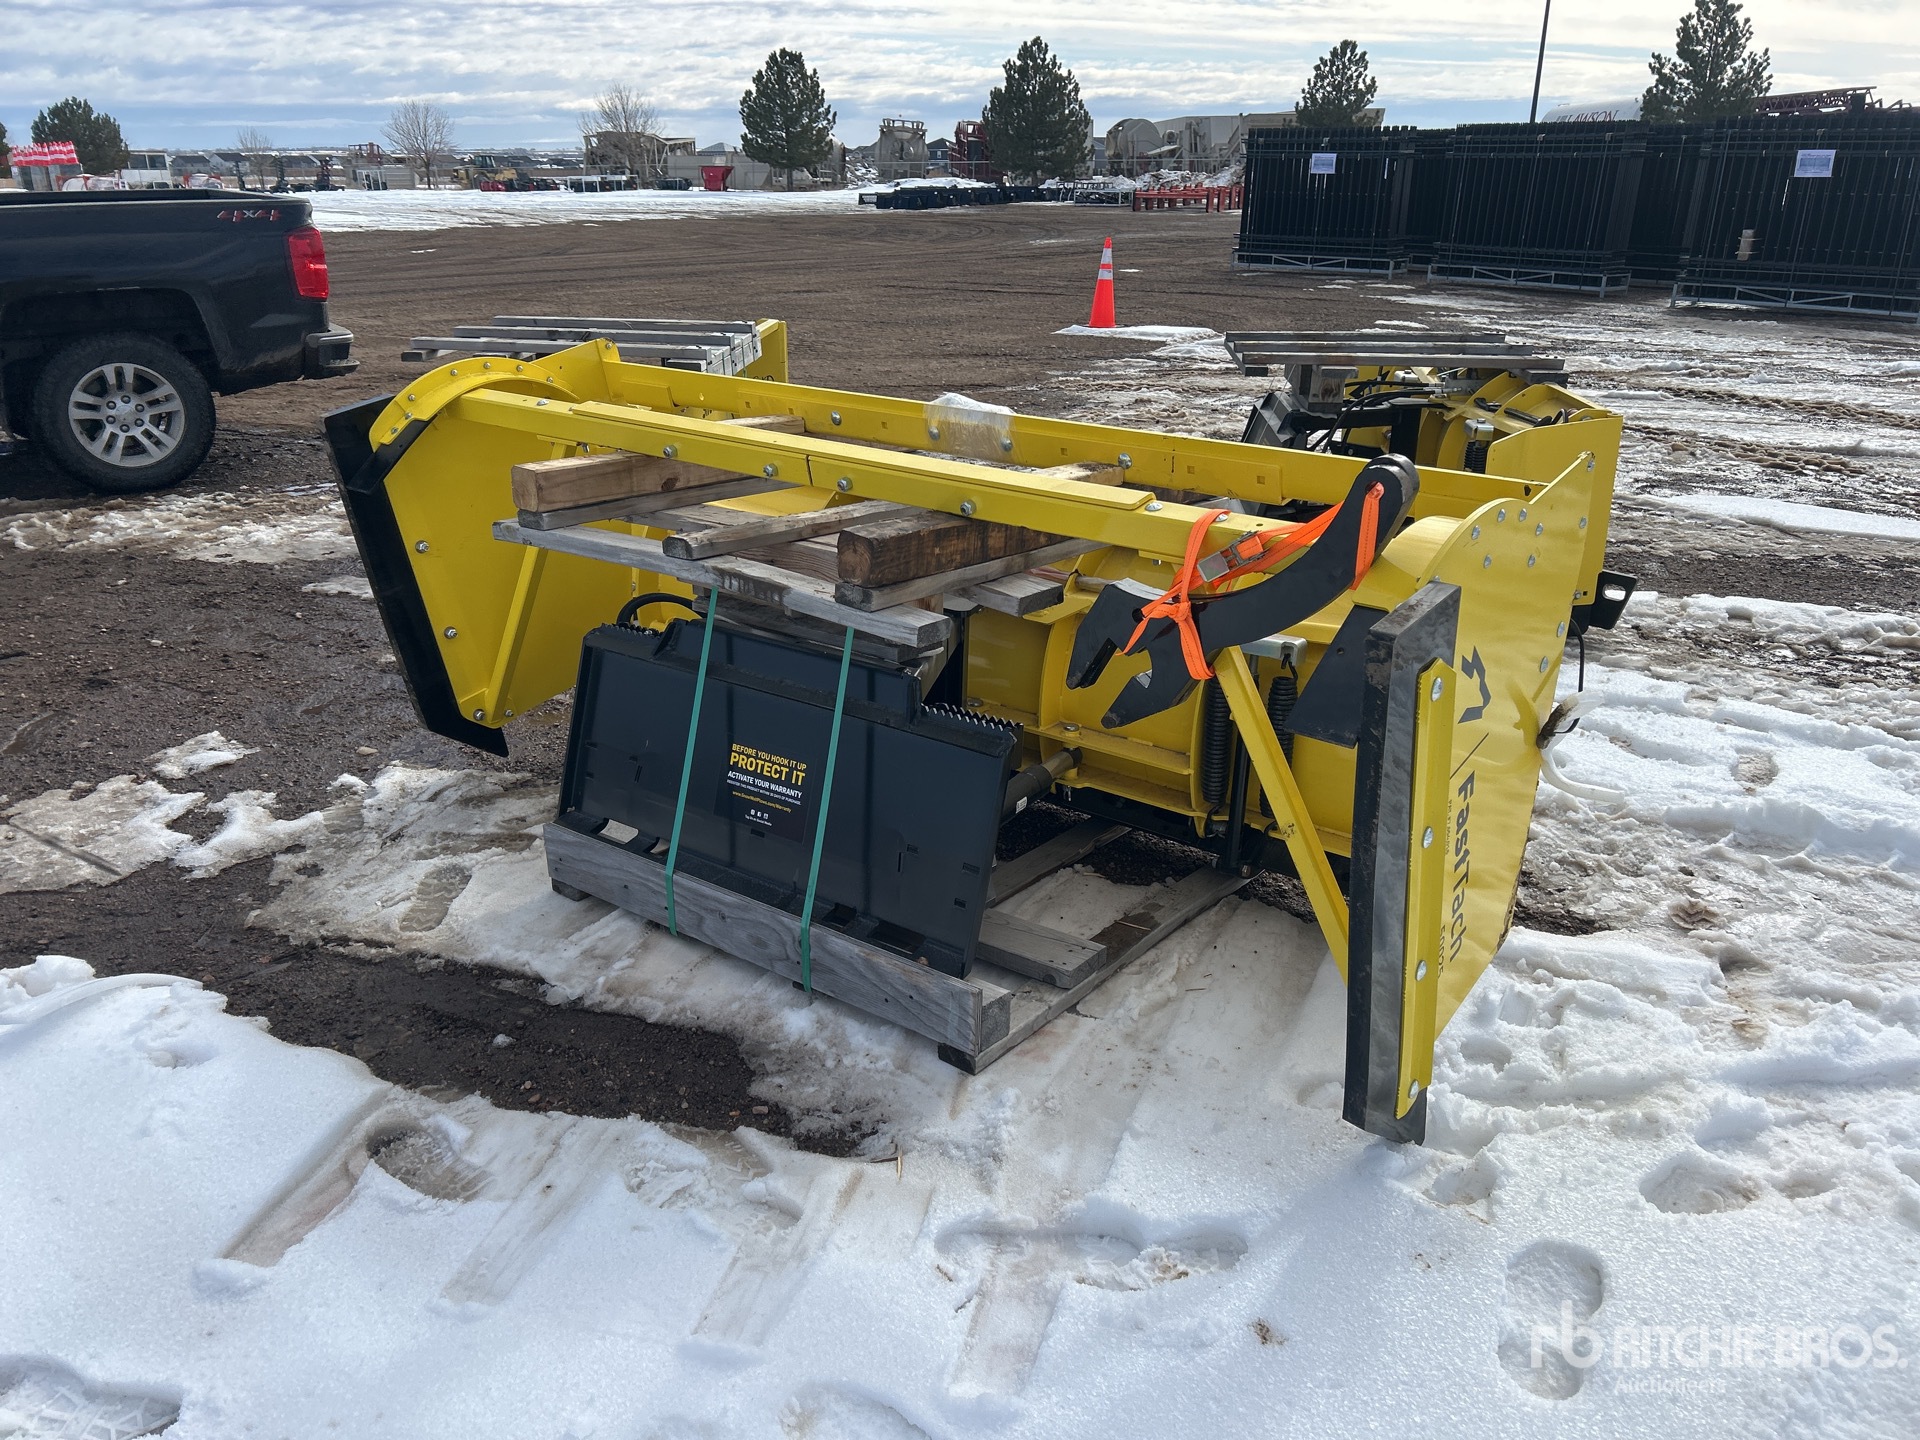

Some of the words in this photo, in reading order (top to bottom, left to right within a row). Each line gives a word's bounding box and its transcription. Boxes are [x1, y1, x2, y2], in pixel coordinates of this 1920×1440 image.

[729, 752, 790, 781] PROTECT
[791, 770, 806, 786] IT
[732, 743, 757, 757] BEFORE
[757, 750, 771, 761] YOU
[771, 754, 790, 766] HOOK
[789, 760, 797, 768] IT
[797, 762, 807, 771] UP
[727, 770, 755, 784] ACTIVATE
[754, 777, 770, 789] YOUR
[769, 783, 803, 799] WARRANTY
[1449, 769, 1475, 963] FastTach
